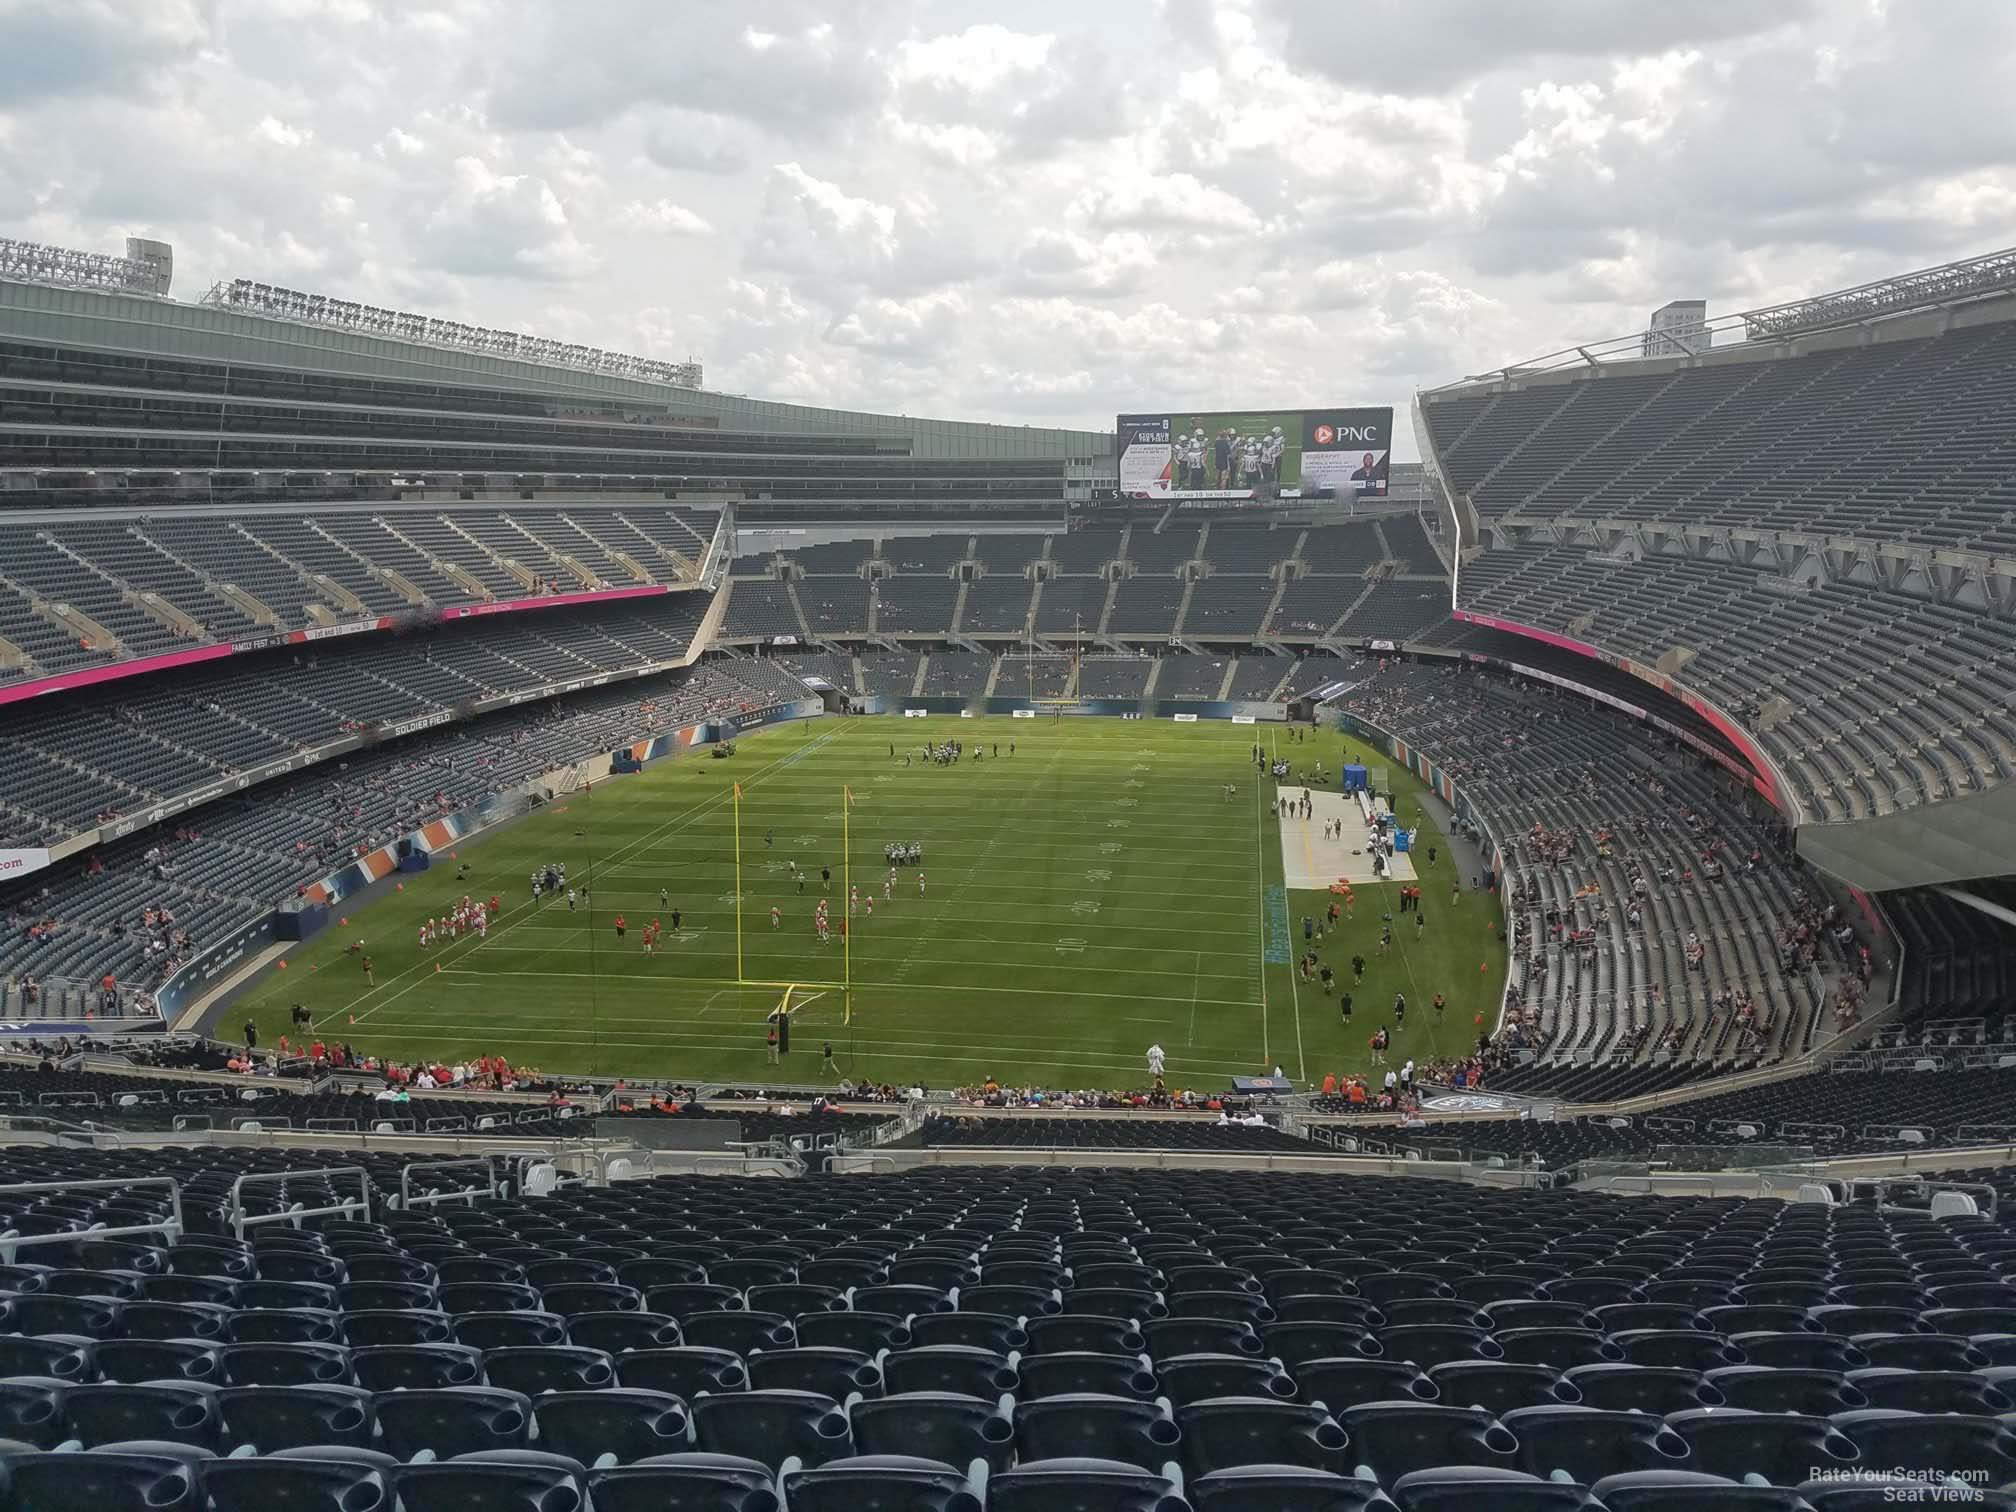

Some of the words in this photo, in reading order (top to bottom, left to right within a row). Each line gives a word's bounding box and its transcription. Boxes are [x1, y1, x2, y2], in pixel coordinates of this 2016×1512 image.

[1336, 426, 1377, 441] PNC
[232, 641, 252, 653] FAMILY
[253, 638, 269, 649] FEST
[395, 719, 428, 736] SOLDIER
[429, 713, 450, 727] FIELD
